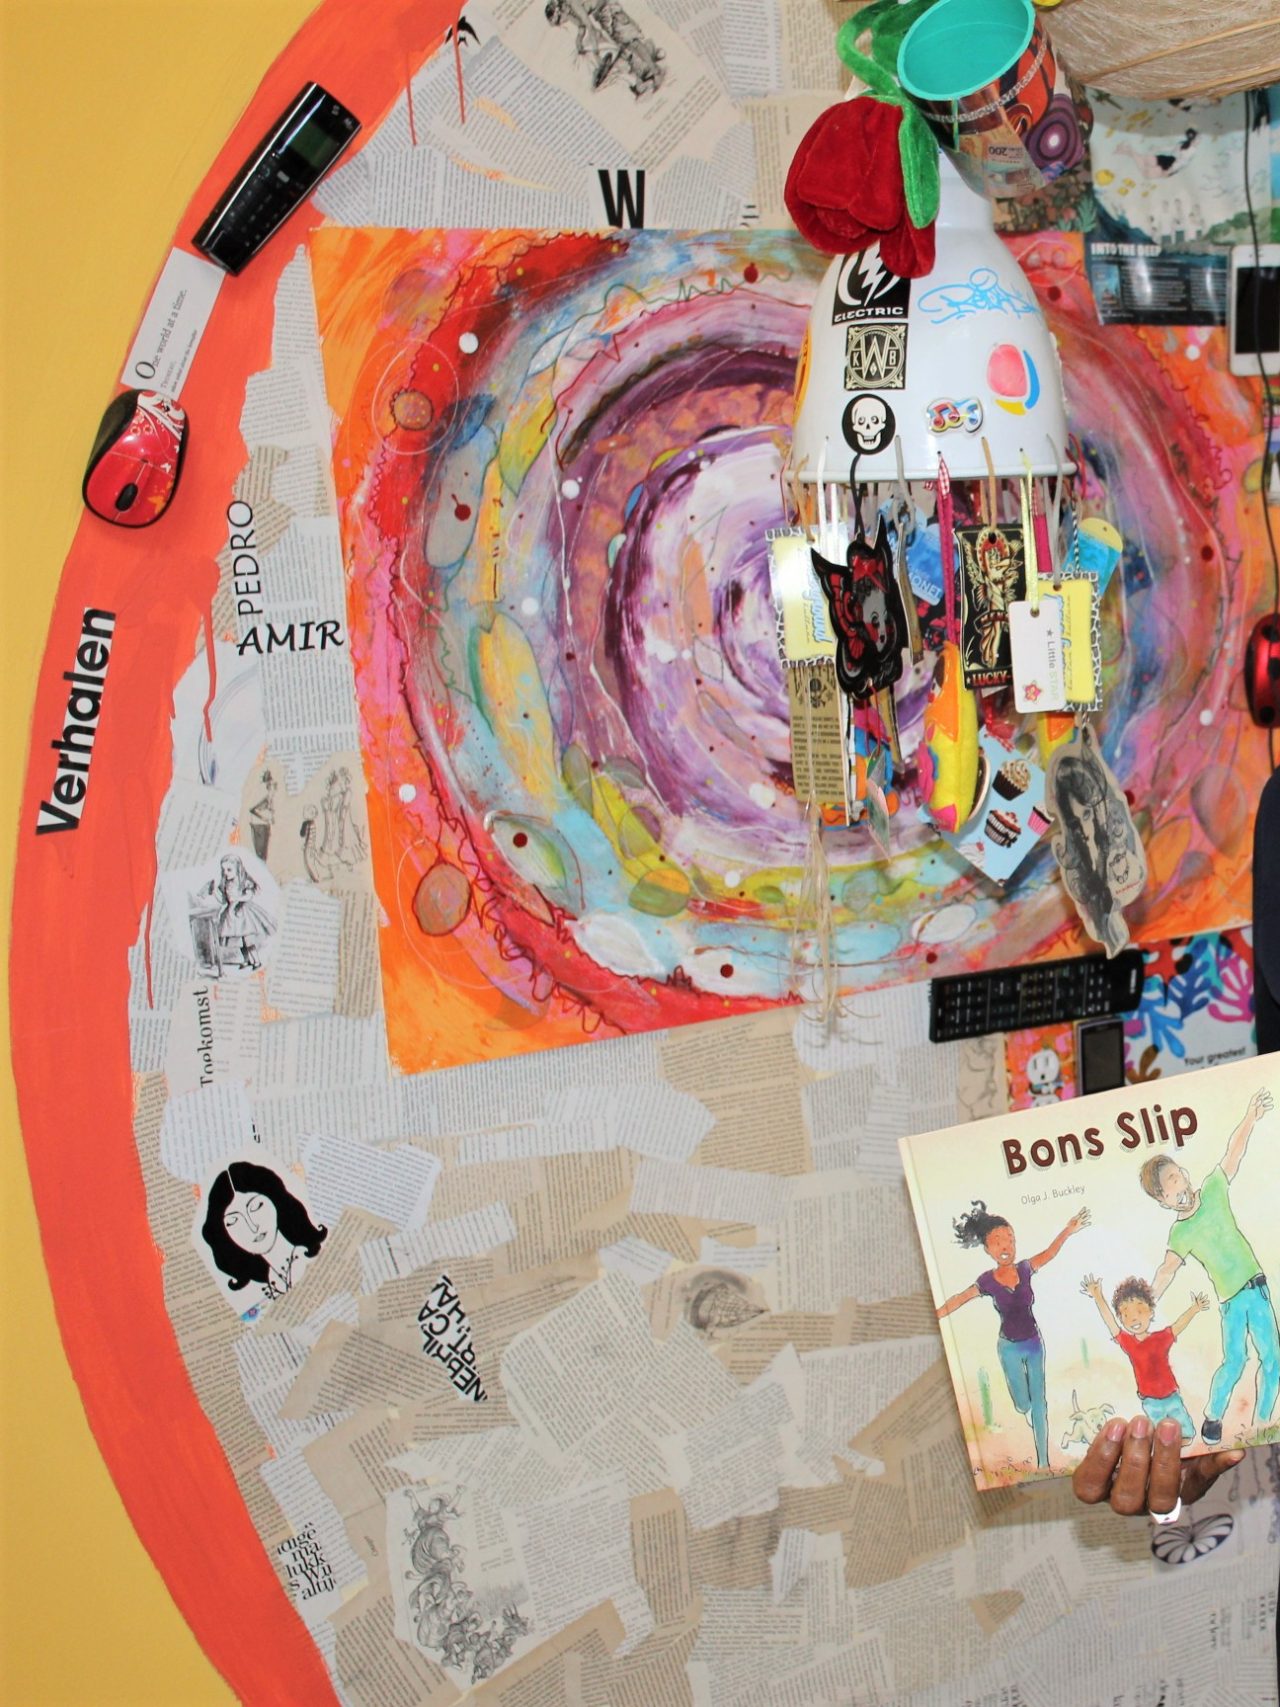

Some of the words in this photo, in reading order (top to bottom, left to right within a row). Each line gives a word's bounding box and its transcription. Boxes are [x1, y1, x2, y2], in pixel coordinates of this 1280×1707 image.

[599, 169, 646, 229] W
[833, 306, 905, 324] ELECTRIC
[134, 349, 161, 380] One
[153, 327, 173, 354] world
[166, 318, 176, 329] at
[227, 500, 264, 616] PEDRO
[236, 620, 345, 656] AMIR
[1048, 641, 1057, 669] Little
[36, 607, 117, 835] Verhalen
[1002, 1127, 1105, 1175] Bons
[1116, 1104, 1198, 1149] Slip
[1020, 1194, 1042, 1206] Olga
[1043, 1191, 1051, 1202] J.
[1052, 1185, 1086, 1199] Buckley
